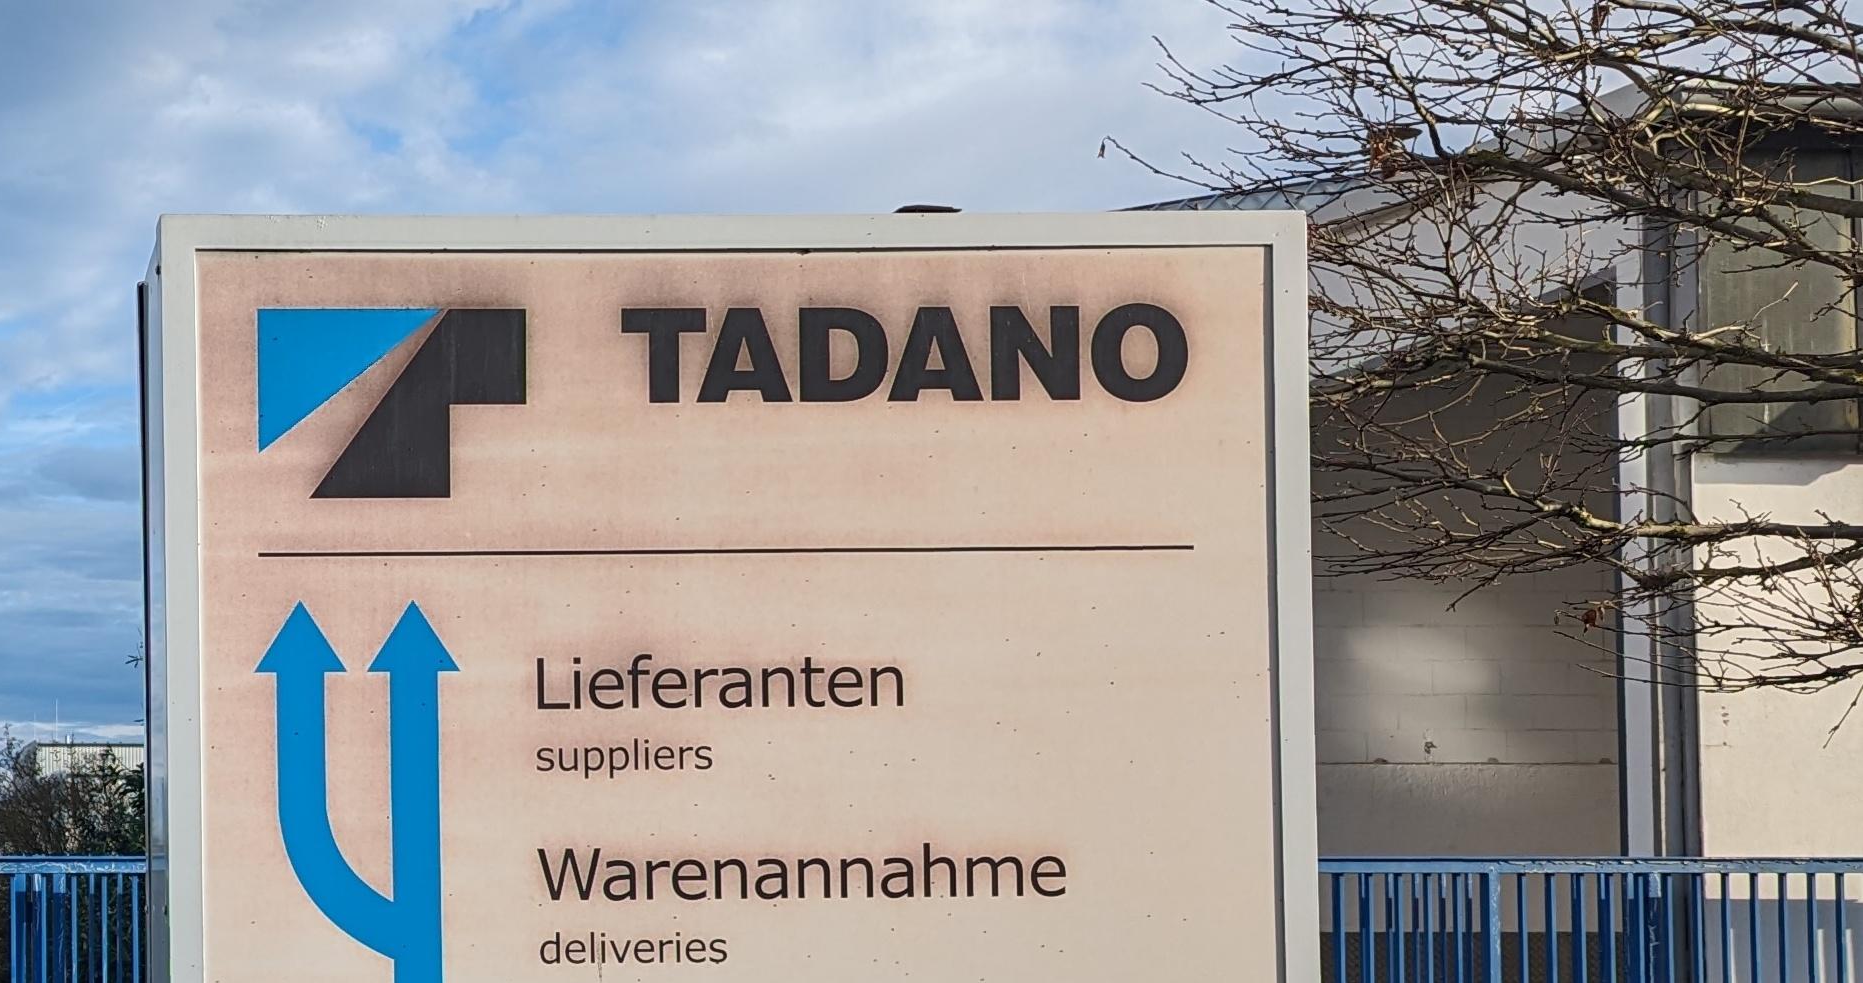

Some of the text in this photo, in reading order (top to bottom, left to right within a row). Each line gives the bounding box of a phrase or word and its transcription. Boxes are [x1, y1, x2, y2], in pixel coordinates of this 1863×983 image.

[621, 303, 1188, 404] TADANO
[536, 653, 904, 710] Lieferanten
[536, 737, 714, 780] suppliers
[536, 843, 1068, 902] Warenannahme
[539, 931, 729, 965] deliveries
